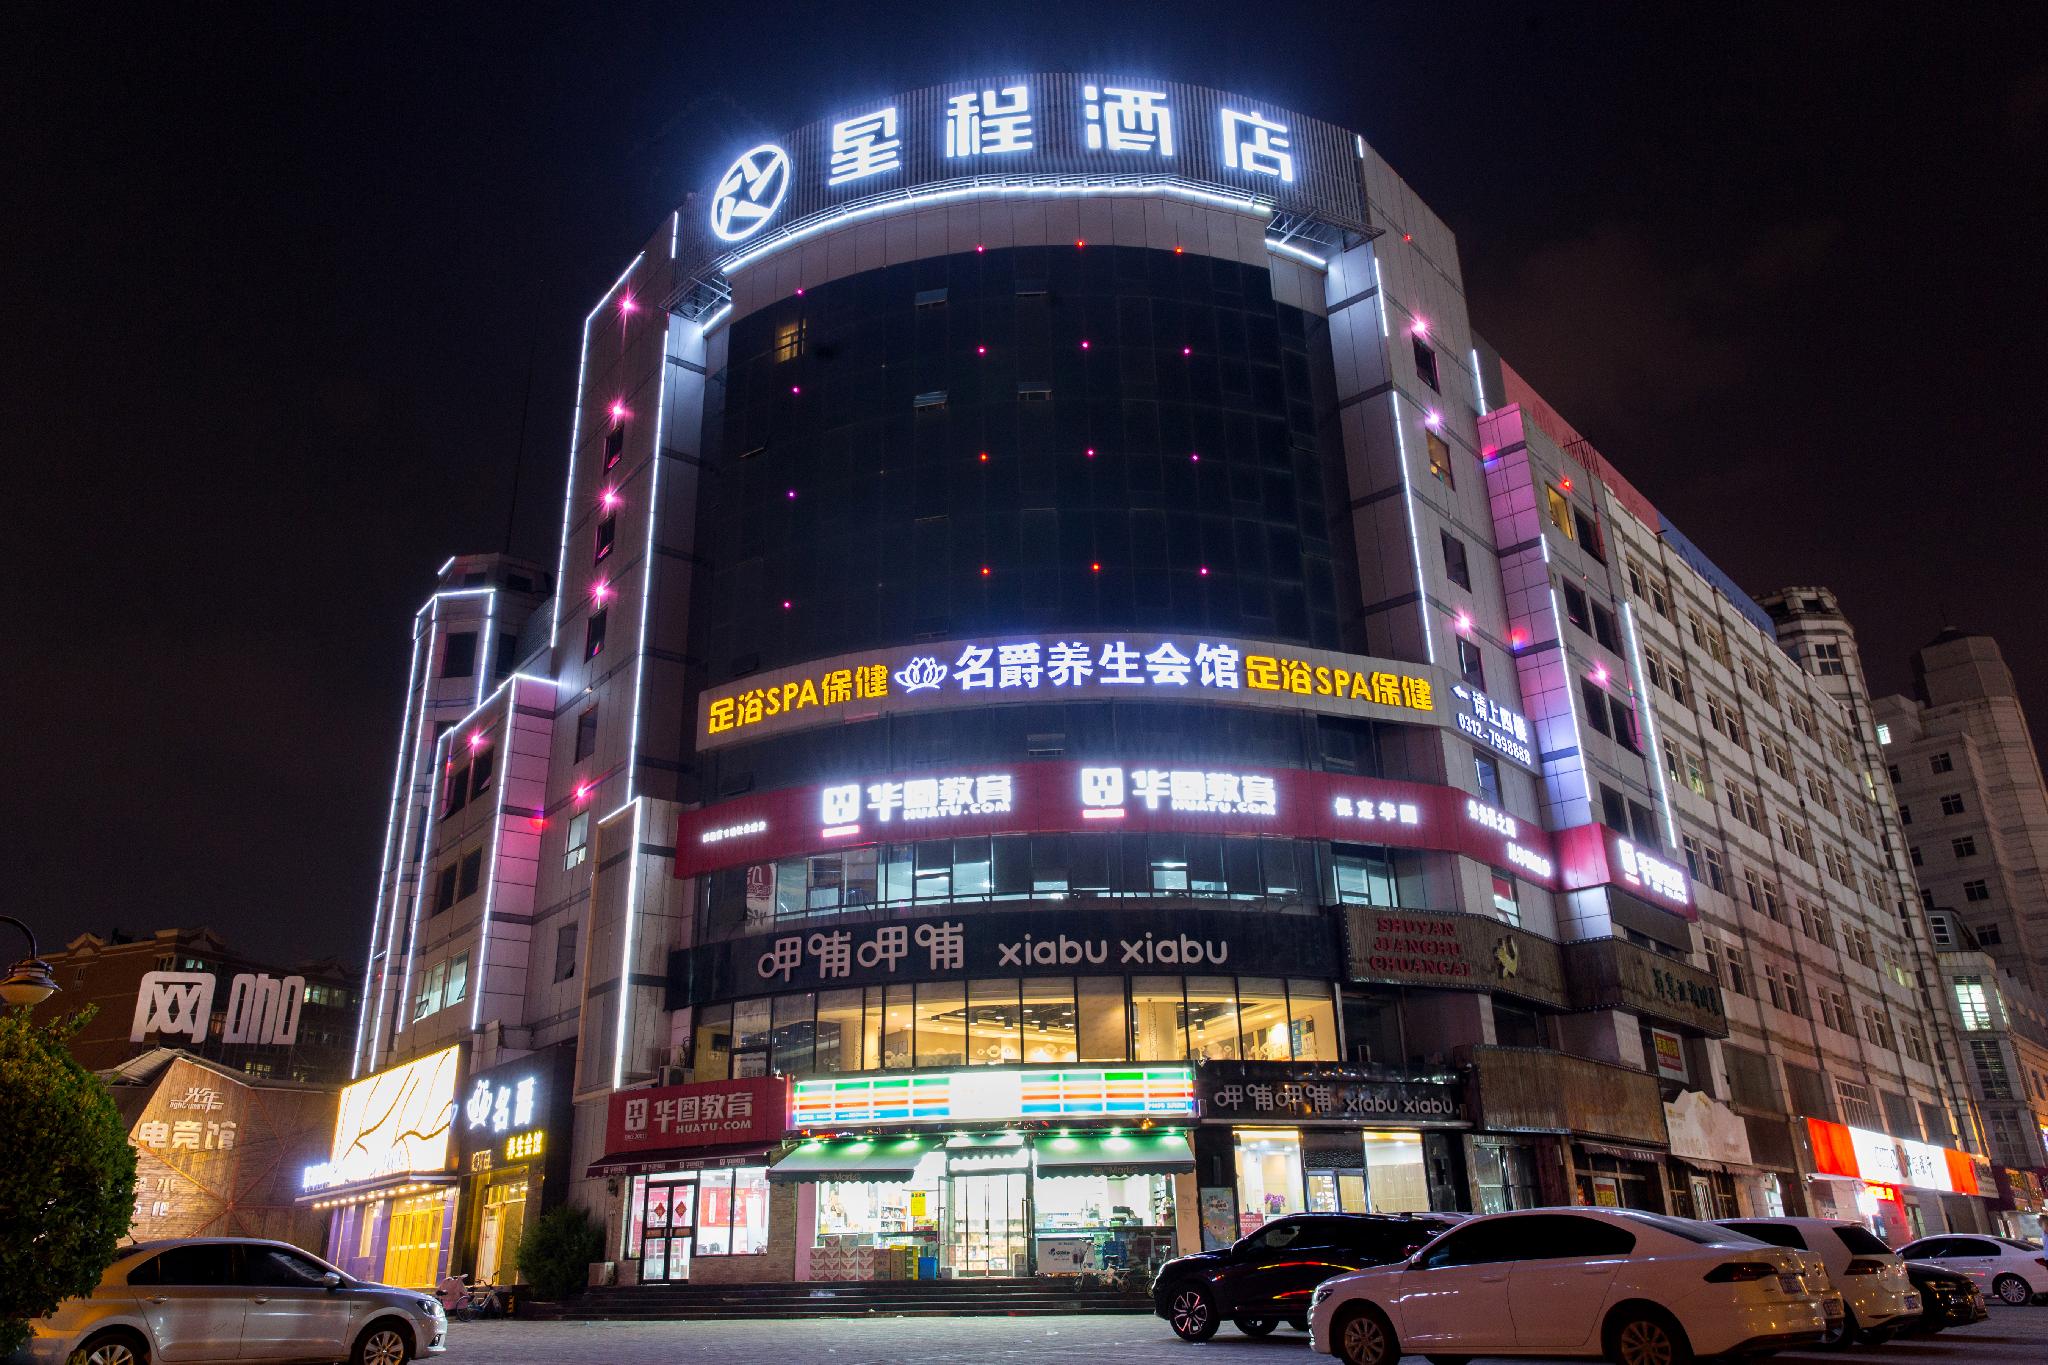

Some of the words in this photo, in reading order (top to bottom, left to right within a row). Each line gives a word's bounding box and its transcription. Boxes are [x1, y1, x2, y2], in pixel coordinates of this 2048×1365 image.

[828, 84, 1294, 186] 星程酒店
[708, 664, 889, 734] 足浴SPA保健
[953, 640, 1240, 691] 名爵养生会馆
[1245, 655, 1434, 711] 足浴SPA保健
[867, 774, 1012, 821] 华图教育
[1131, 769, 1276, 809] 华图教育
[1377, 916, 1457, 937] SHUYAN
[757, 920, 965, 982] 呷哺呷哺
[998, 933, 1108, 967] xiabu
[1120, 931, 1229, 965] xiabu
[130, 970, 306, 1046] 网咖
[653, 1092, 753, 1133] 华图教育
[1214, 1083, 1332, 1116] 呷哺呷哺
[1345, 1095, 1398, 1113] xiabu
[1403, 1095, 1454, 1114] xiabu
[138, 1120, 237, 1150] 电竞馆
[676, 1120, 752, 1134] HUATU.COM
